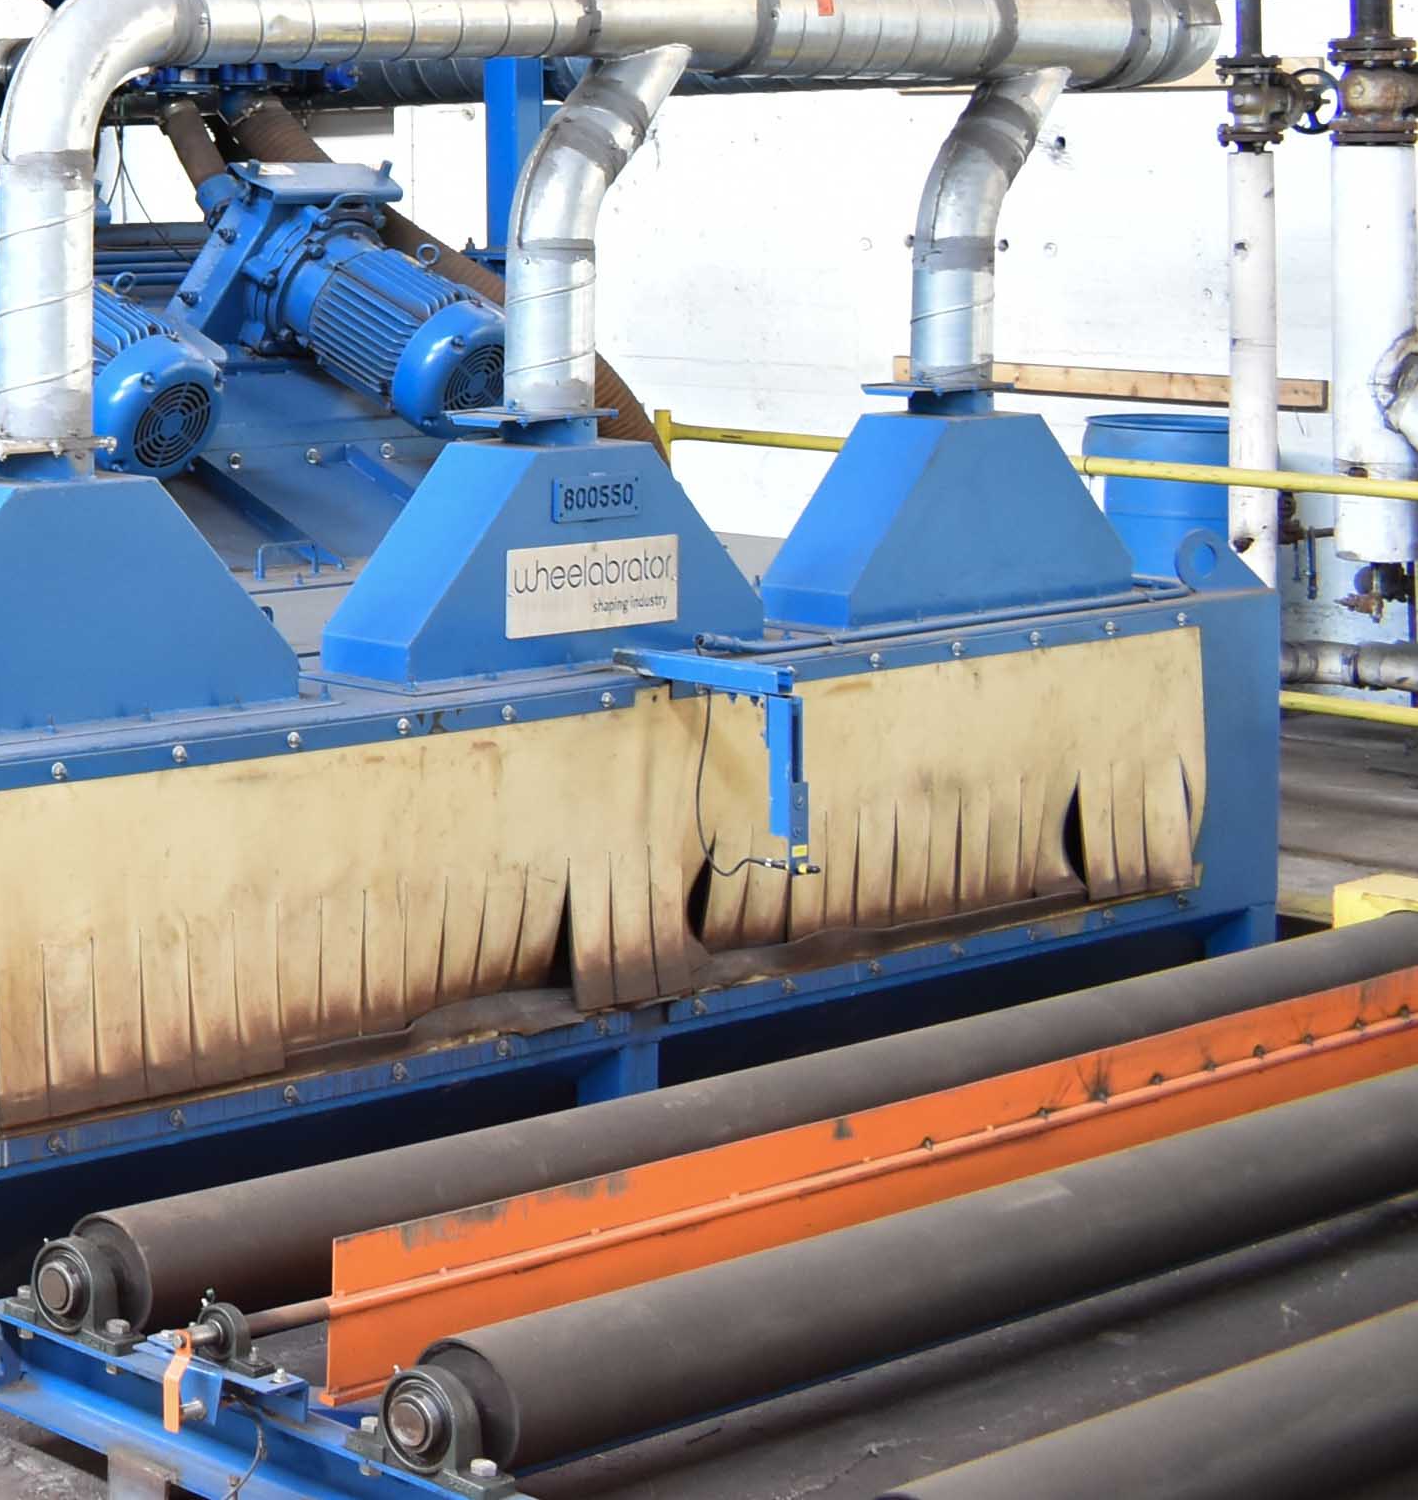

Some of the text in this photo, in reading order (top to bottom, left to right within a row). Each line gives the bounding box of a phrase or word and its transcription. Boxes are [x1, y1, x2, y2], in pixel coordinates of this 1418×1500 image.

[563, 483, 634, 511] 800550
[514, 550, 671, 593] wheelabrator
[592, 594, 668, 615] shaping industry
